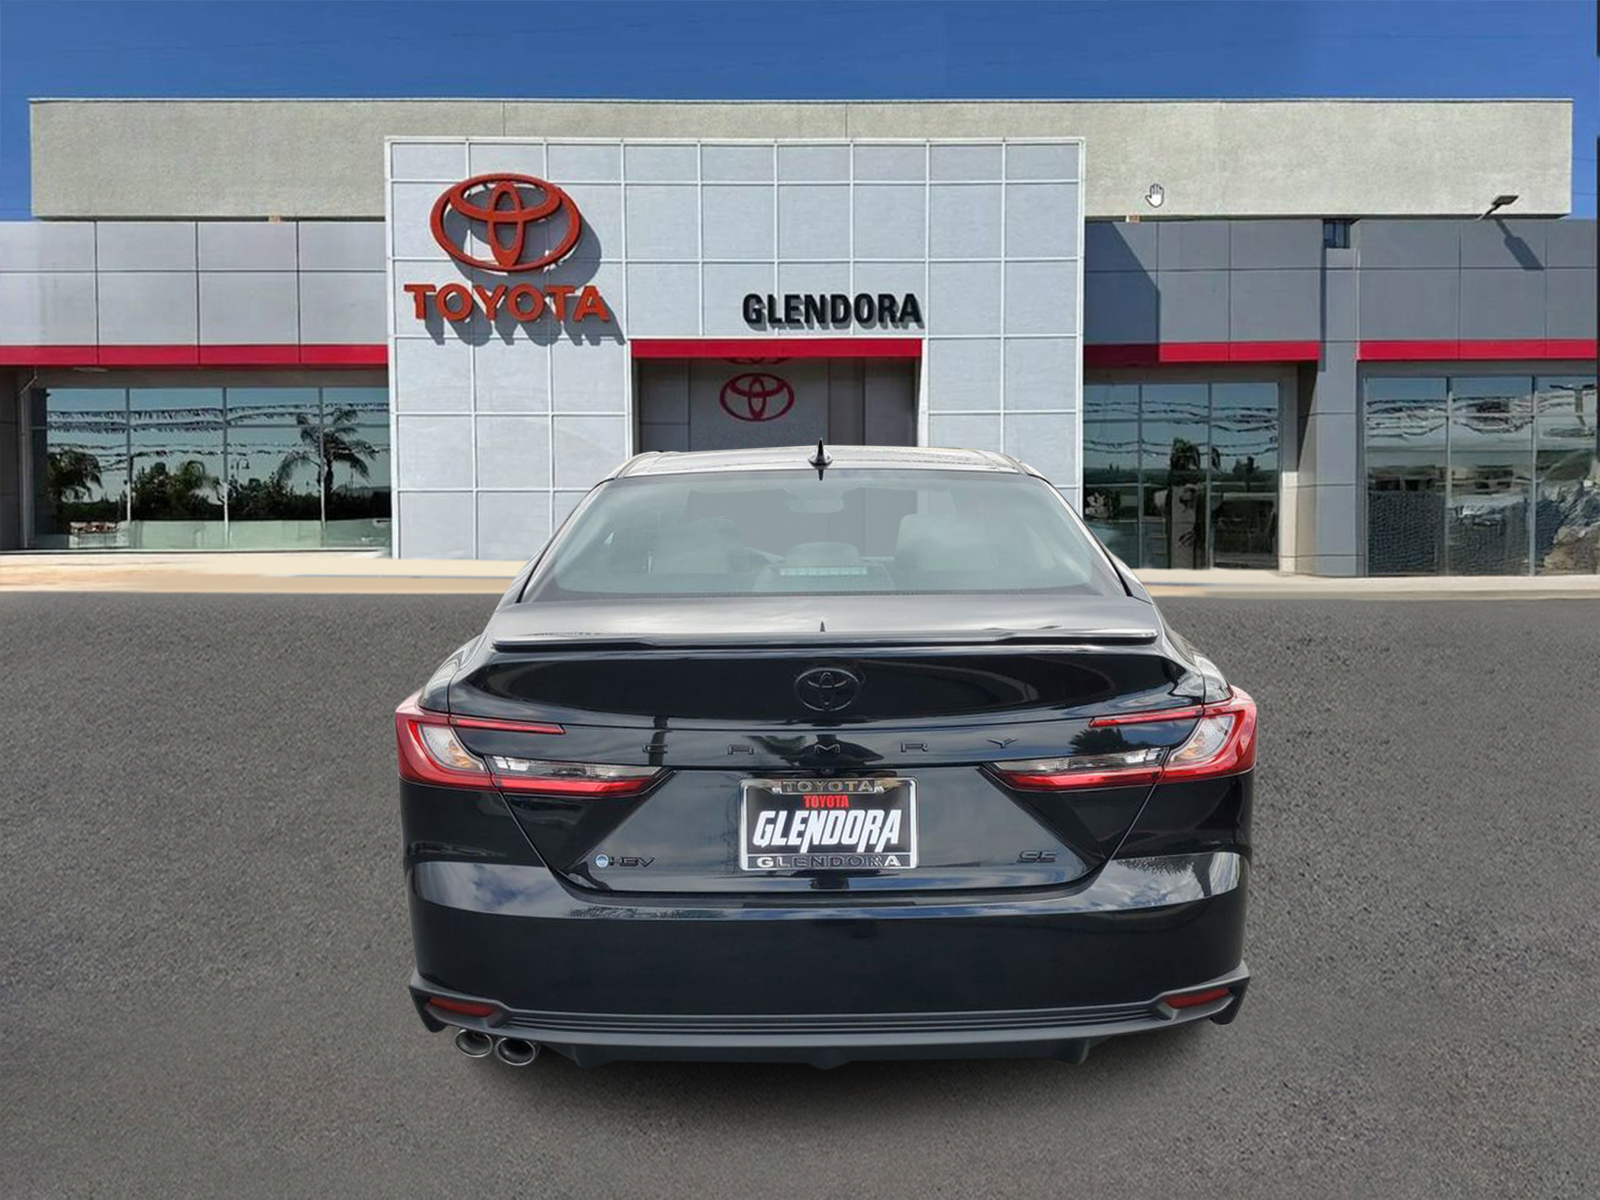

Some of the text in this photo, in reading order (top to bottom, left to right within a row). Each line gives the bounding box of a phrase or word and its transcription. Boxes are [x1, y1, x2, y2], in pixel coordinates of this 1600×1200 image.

[404, 283, 609, 321] TOYOTA
[743, 293, 921, 325] GLENDORA
[784, 780, 874, 792] TOYOTA
[803, 795, 850, 808] TOYOTA
[752, 809, 902, 853] GLENDORA
[756, 856, 902, 868] GLENDORA
[1016, 850, 1056, 864] SE
